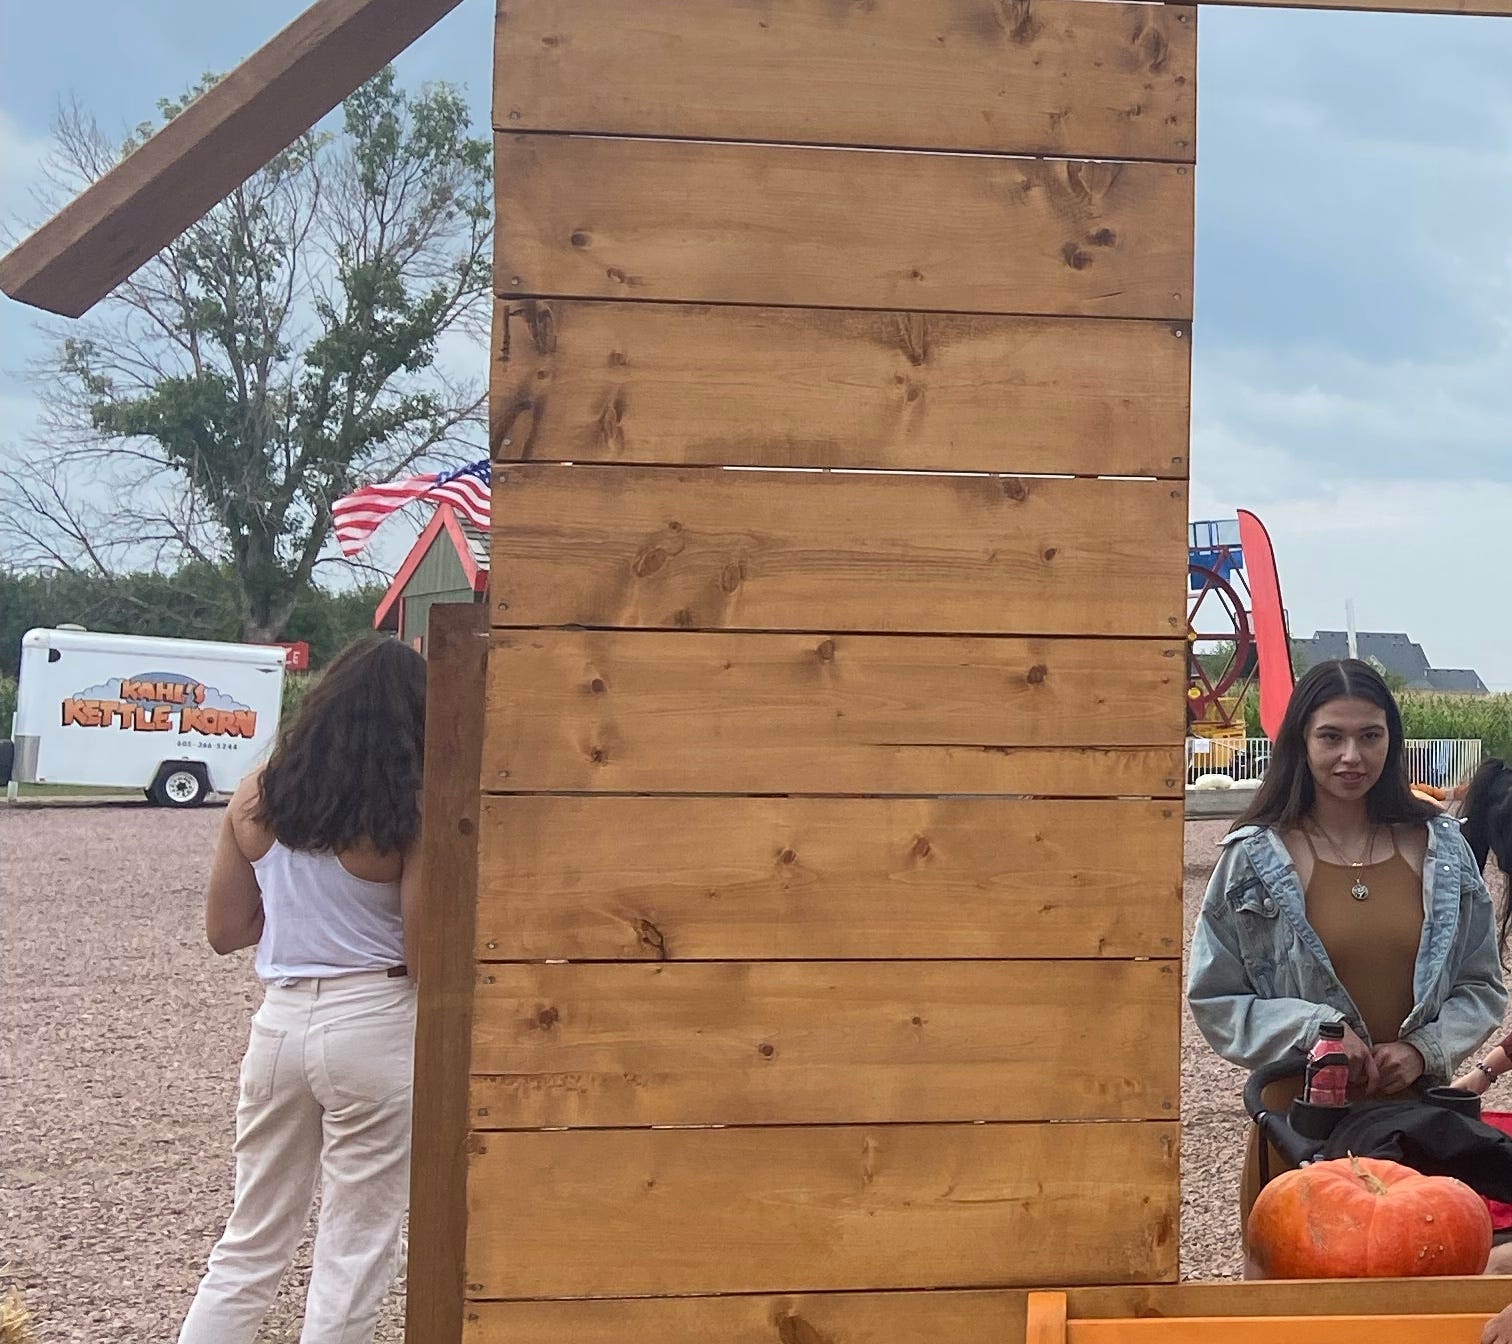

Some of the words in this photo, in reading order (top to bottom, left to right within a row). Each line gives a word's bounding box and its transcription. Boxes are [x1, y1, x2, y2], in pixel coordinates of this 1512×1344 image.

[120, 679, 206, 704] KAHL'S
[62, 698, 172, 731] KETTLE
[179, 707, 257, 738] KORN
